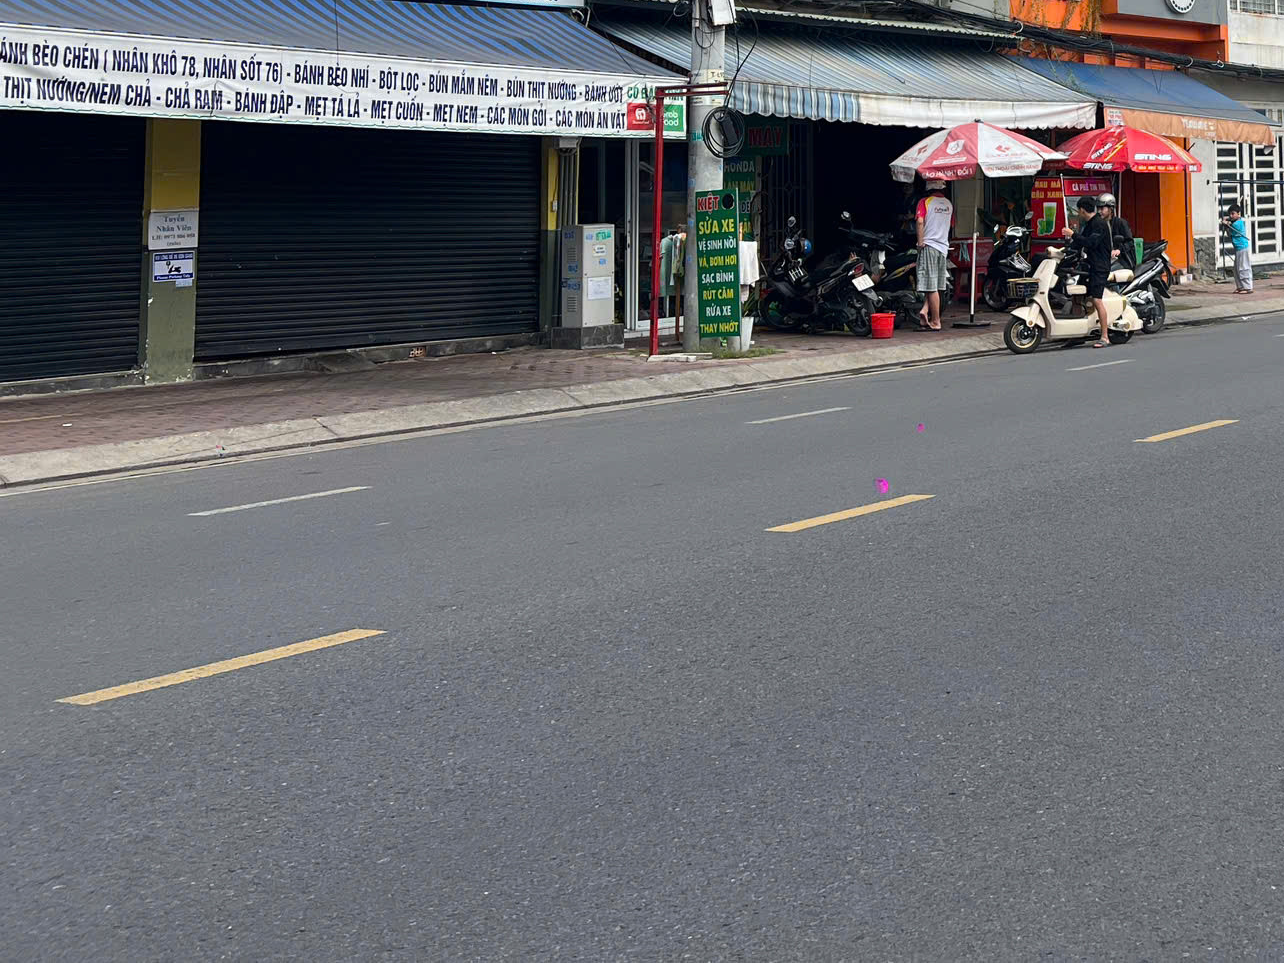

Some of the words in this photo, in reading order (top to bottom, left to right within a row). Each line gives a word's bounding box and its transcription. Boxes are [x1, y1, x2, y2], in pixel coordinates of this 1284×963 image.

[33, 40, 59, 67] BÈO
[63, 43, 99, 70] CHÉN
[152, 50, 177, 76] KHÔ
[181, 56, 199, 79] 78,
[203, 54, 237, 80] NHÂN
[240, 53, 262, 81] SỐT
[265, 62, 283, 84] 76)
[294, 60, 324, 85] BÁNH
[327, 63, 348, 87] BÈO
[351, 65, 369, 88] NHÍ
[379, 67, 398, 94] BỘT
[401, 73, 419, 95] LỌC
[429, 71, 448, 93] BÚN
[451, 69, 475, 95] MẮM
[506, 76, 525, 98] BÚN
[528, 81, 546, 103] THỊT
[548, 80, 577, 101] NƯỚNG
[584, 82, 606, 102] BÁNH
[4, 76, 31, 104] THỊT
[125, 79, 150, 107] CHẢ
[165, 82, 191, 109] CHẢ
[195, 88, 222, 111] RAM
[235, 88, 267, 114] BÁNH
[270, 90, 293, 118] ĐẬP
[304, 95, 328, 120] MẸT
[332, 93, 344, 117] TÁ
[347, 92, 360, 118] LẢ
[371, 99, 393, 124] MẸT
[396, 96, 423, 121] CUỐN
[433, 103, 454, 126] MẸT
[456, 105, 478, 124] NEM
[487, 103, 506, 124] CÁC
[508, 104, 530, 126] MÓN
[532, 102, 547, 126] GỎI
[555, 106, 572, 128] CÁC
[575, 107, 594, 128] MÓN
[596, 107, 608, 129] ĂN
[610, 109, 626, 133] VẶT
[1134, 153, 1172, 161] STING
[697, 192, 720, 214] KIỆT
[698, 216, 720, 235] SỬA
[721, 219, 735, 232] XE
[698, 238, 706, 253] VỆ
[707, 239, 723, 250] SINH
[724, 235, 737, 249] NỒI
[710, 256, 724, 267] BƠM
[702, 273, 714, 285] SẠC
[716, 270, 734, 282] BÌNH
[722, 306, 731, 316] XE
[700, 323, 718, 334] THAY
[720, 320, 738, 333] NHỚT
